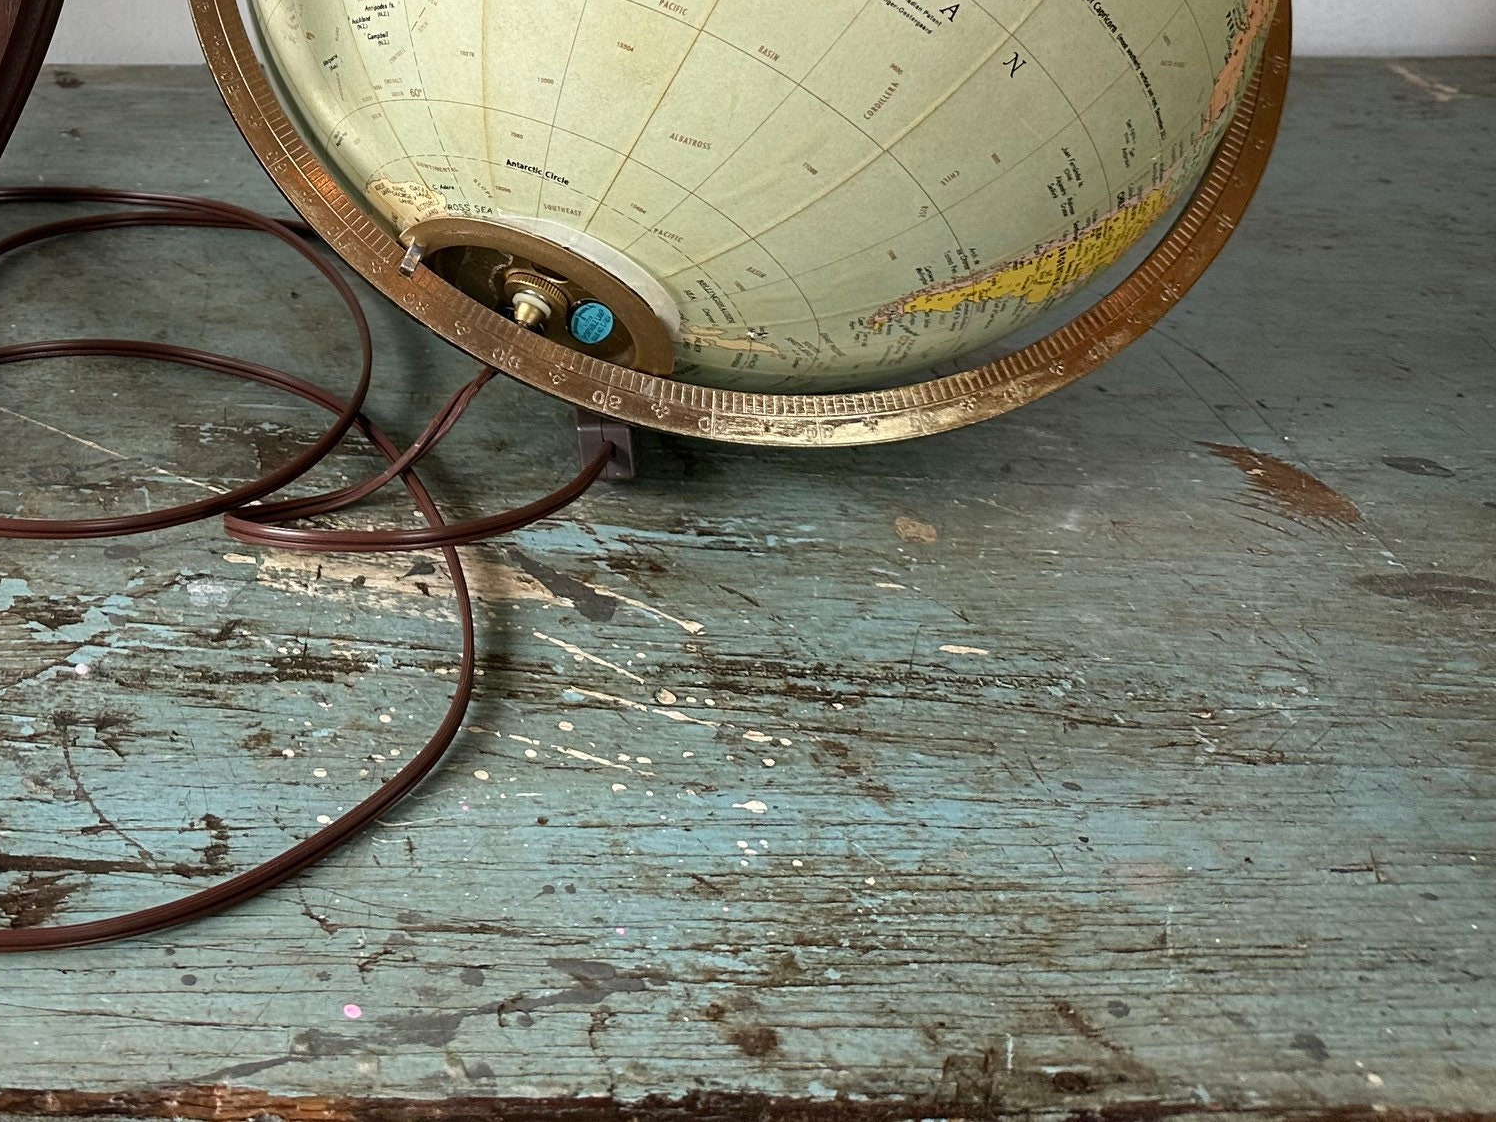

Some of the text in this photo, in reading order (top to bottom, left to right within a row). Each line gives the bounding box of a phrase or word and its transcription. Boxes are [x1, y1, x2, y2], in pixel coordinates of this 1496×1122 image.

[922, 9, 942, 27] Patent
[1094, 2, 1118, 34] Capricorn
[757, 45, 781, 63] BASIN
[862, 80, 899, 120] CORDILLERA
[669, 132, 712, 150] ALBATROSS
[506, 159, 570, 186] Antarctic Circle
[447, 203, 493, 215] ROSS SEA
[653, 227, 684, 244] PACIFIC
